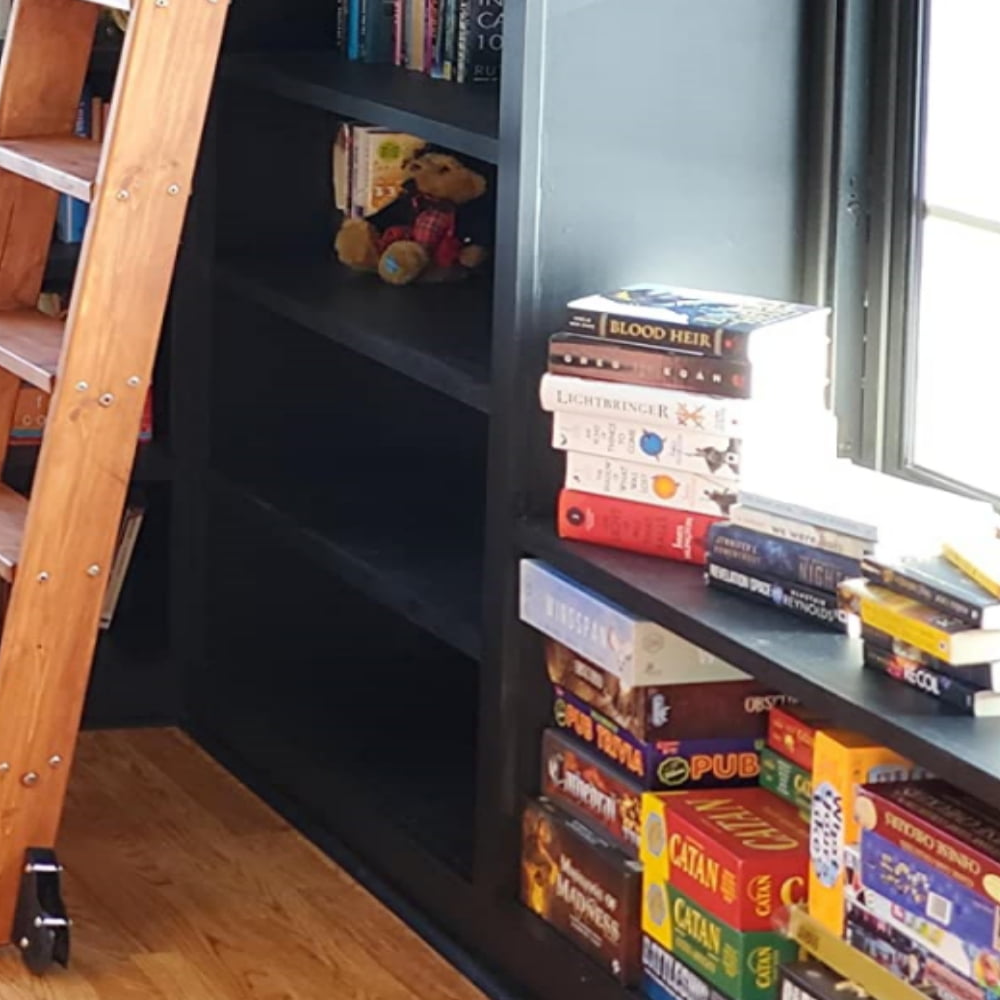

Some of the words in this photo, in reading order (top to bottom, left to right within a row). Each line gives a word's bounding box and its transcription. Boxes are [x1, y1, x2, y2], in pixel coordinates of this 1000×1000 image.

[610, 319, 666, 340] BLOOD
[669, 324, 711, 348] HEIR
[663, 366, 723, 384] EGAN
[556, 389, 669, 420] LIGHTBRINGER
[545, 596, 607, 649] WINGSPAN
[782, 594, 834, 623] REYNOLDS
[564, 704, 594, 742] PUB
[596, 723, 644, 777] TRIVIA
[691, 752, 761, 781] PUB
[669, 833, 718, 893] CATAN
[556, 872, 620, 946] MADNESS
[674, 897, 722, 954] CATAN
